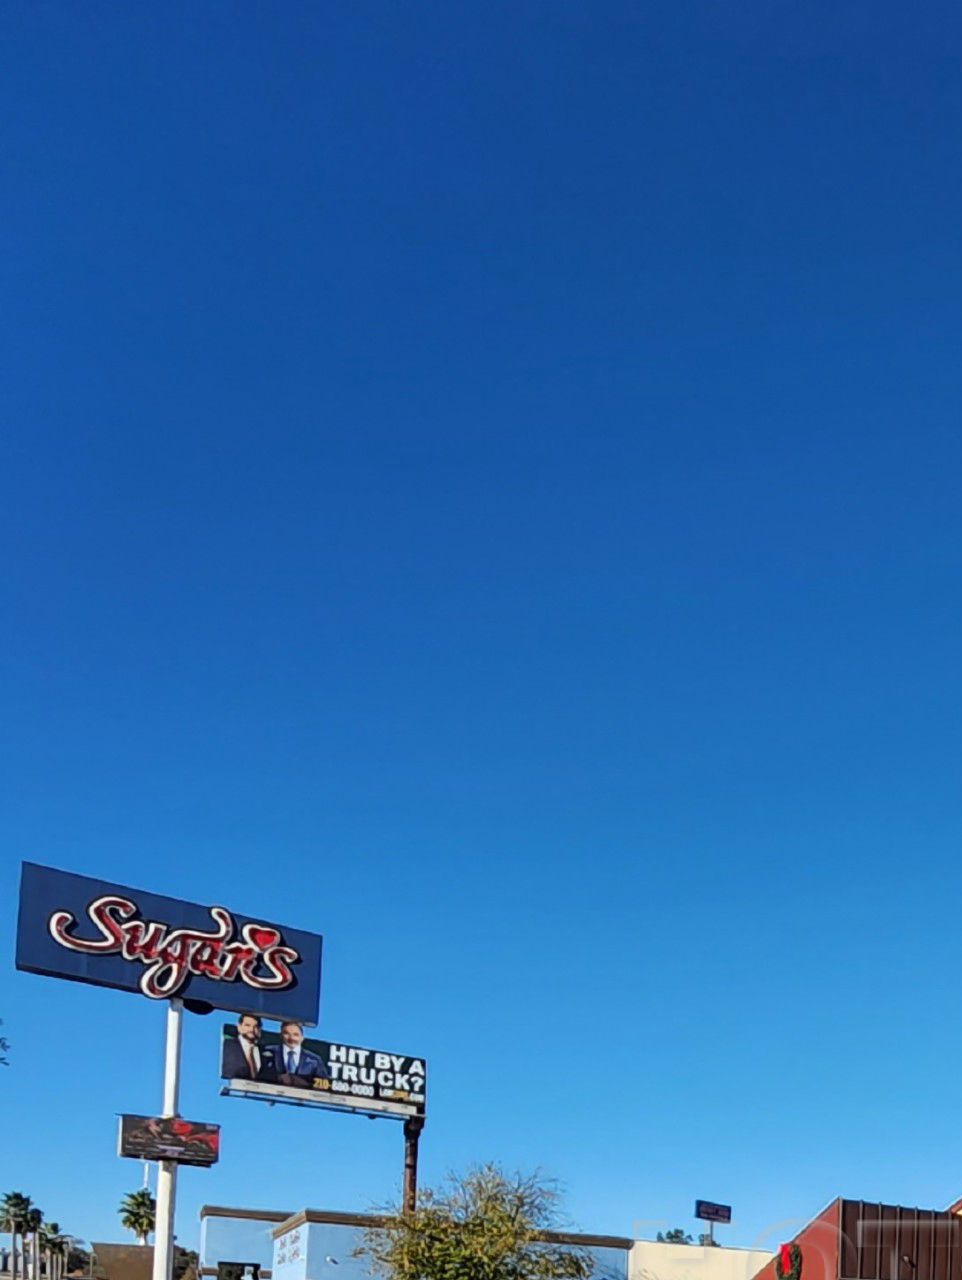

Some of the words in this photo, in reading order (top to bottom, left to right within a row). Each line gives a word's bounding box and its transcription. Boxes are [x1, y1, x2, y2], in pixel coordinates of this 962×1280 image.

[49, 895, 299, 1000] Sugar's
[327, 1061, 424, 1091] TRUCK?
[329, 1045, 369, 1066] HIT
[375, 1053, 405, 1072] BY
[409, 1060, 424, 1076] A
